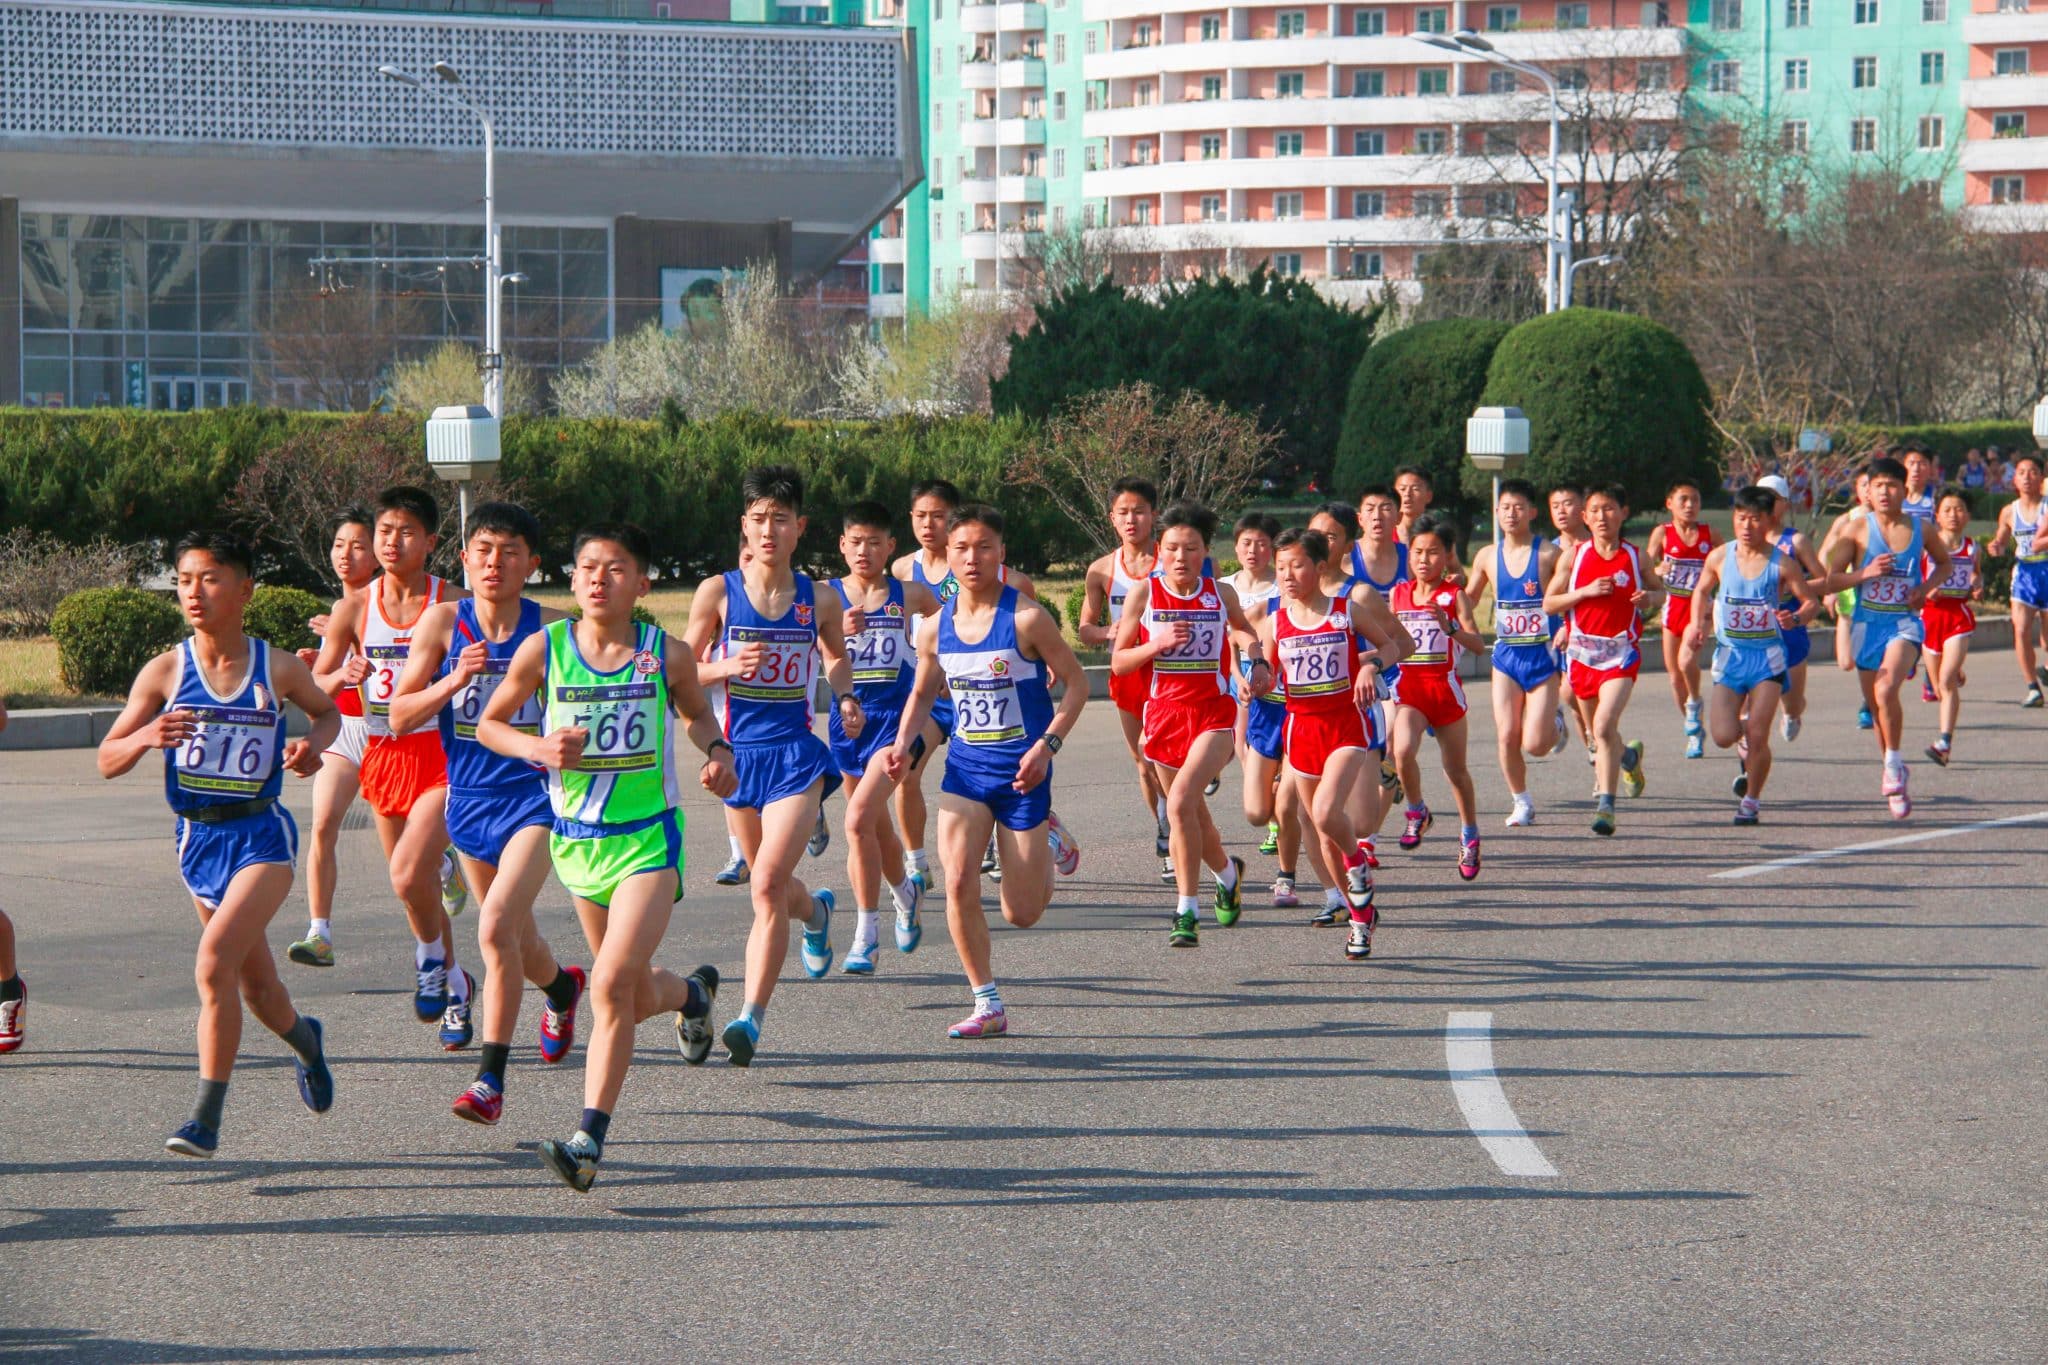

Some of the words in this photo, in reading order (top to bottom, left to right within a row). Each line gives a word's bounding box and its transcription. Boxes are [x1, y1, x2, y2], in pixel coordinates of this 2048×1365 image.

[1867, 581, 1908, 603] 333
[1503, 614, 1542, 635] 308
[1728, 610, 1769, 629] 334
[1290, 651, 1340, 682] 786
[958, 697, 1010, 727] 637
[573, 711, 647, 751] 566
[186, 733, 262, 775] 616
